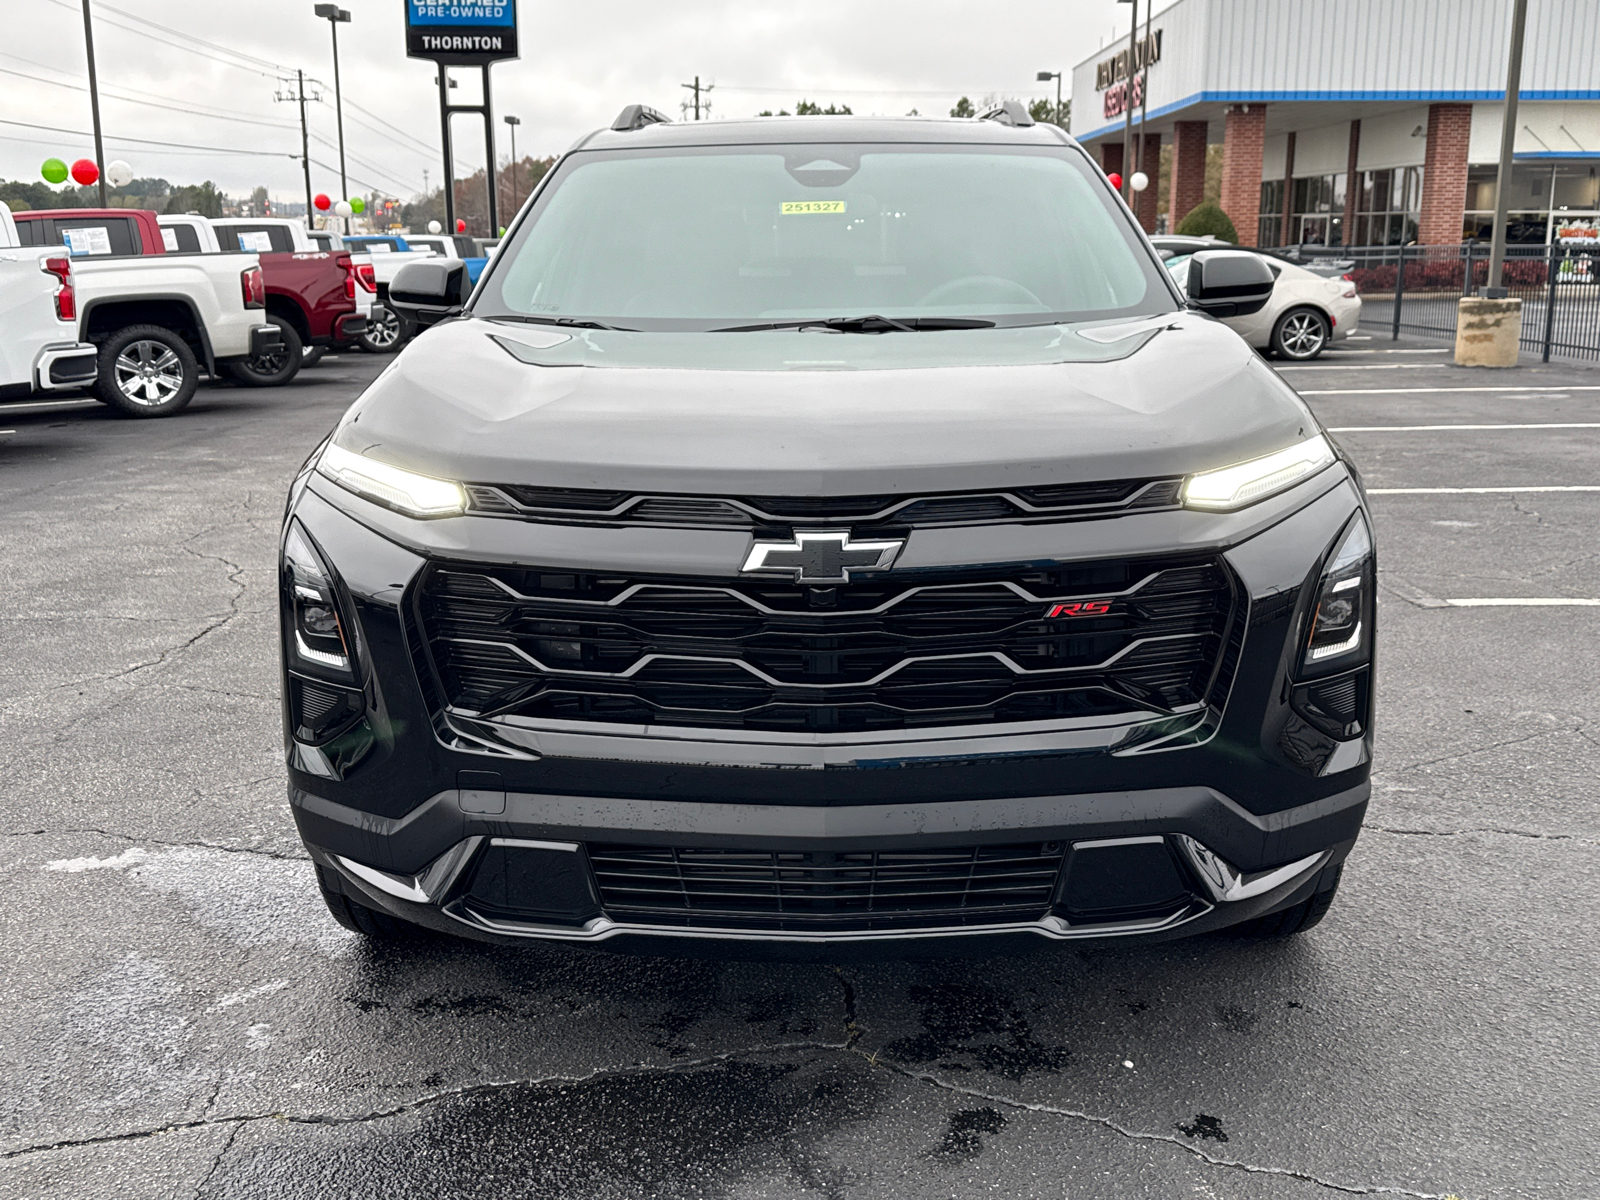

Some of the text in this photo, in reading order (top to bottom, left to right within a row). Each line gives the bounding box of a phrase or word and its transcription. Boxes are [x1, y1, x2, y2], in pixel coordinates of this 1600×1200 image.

[418, 6, 503, 17] PRE-OWNED
[422, 36, 502, 50] THORNTON
[784, 202, 841, 212] 251327
[1045, 600, 1114, 618] RS
